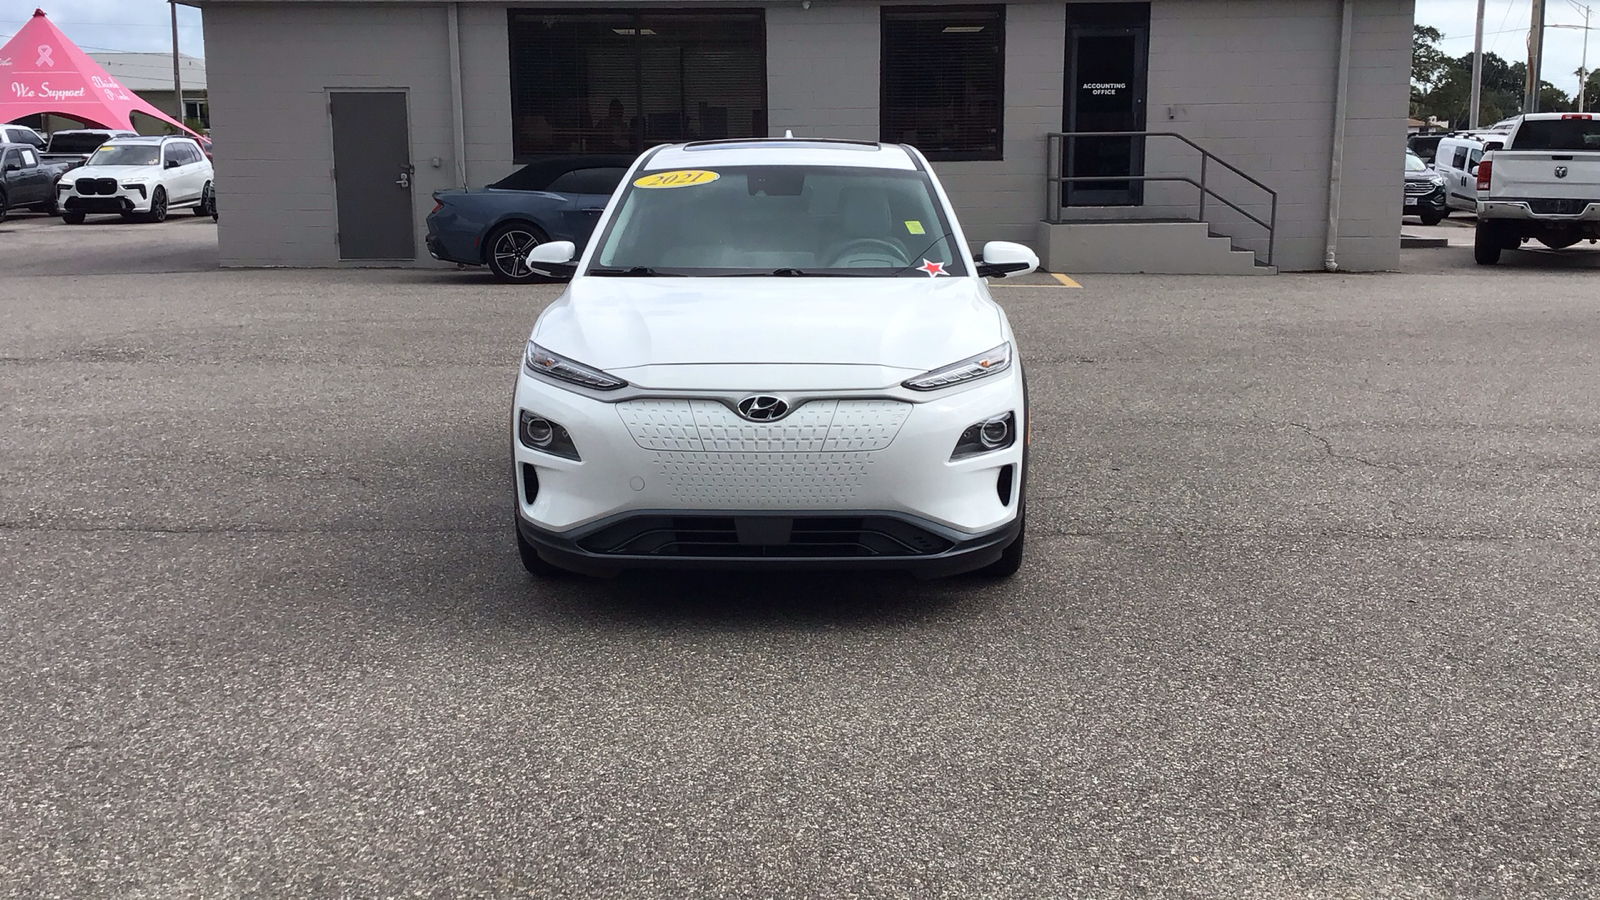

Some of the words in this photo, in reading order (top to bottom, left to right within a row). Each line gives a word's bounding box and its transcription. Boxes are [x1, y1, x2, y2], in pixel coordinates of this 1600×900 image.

[11, 81, 35, 97] We
[38, 81, 85, 101] Support
[647, 171, 705, 186] 2021
